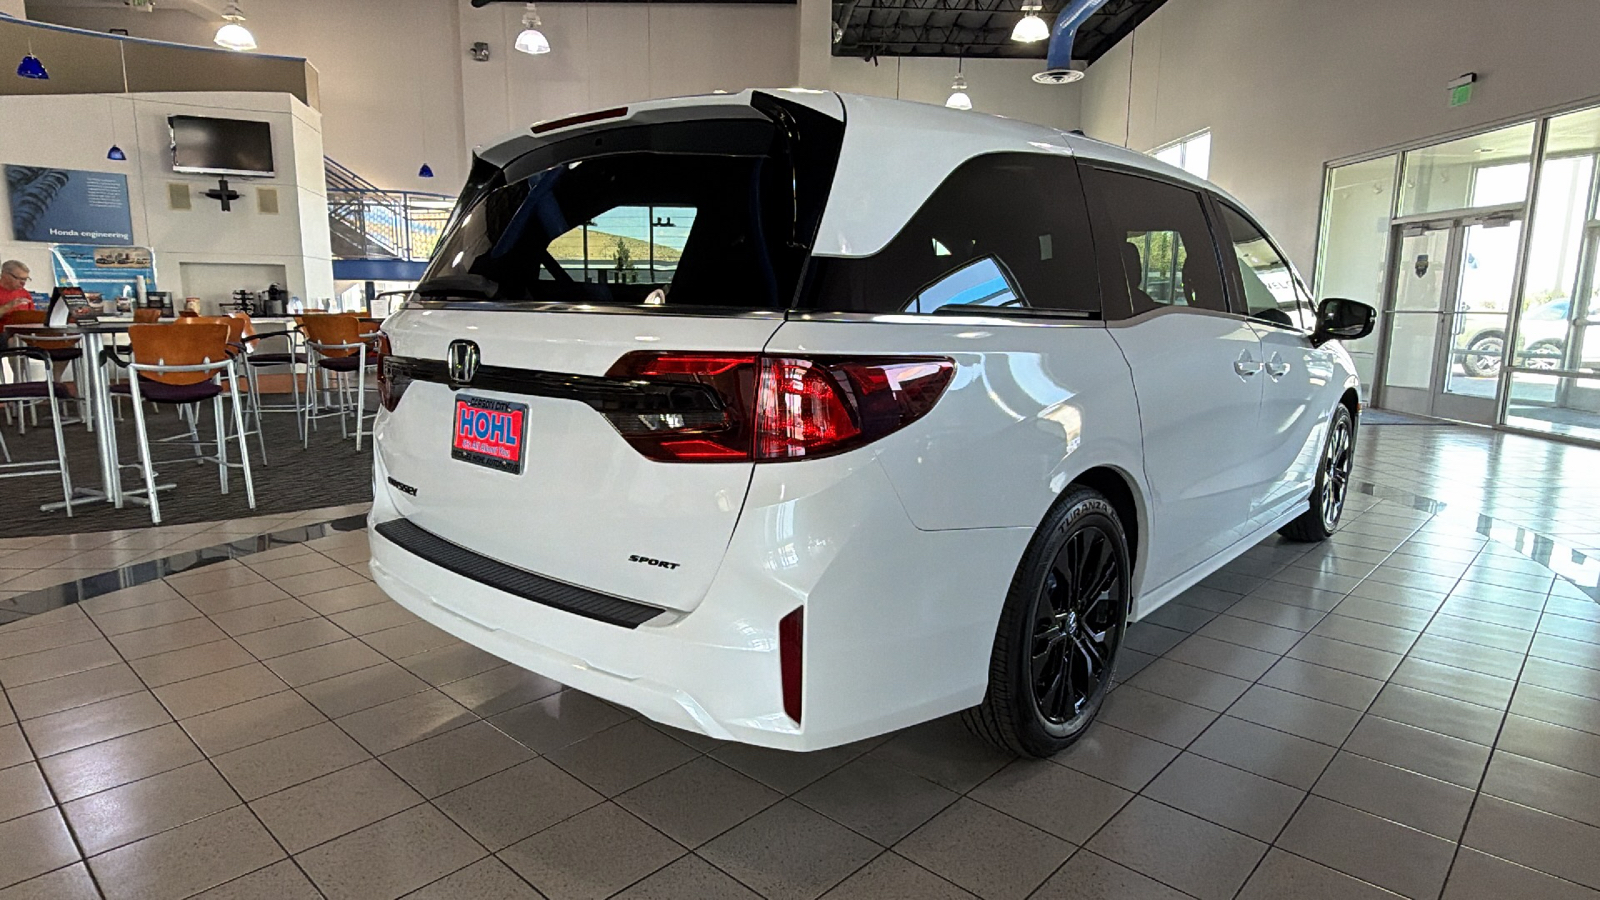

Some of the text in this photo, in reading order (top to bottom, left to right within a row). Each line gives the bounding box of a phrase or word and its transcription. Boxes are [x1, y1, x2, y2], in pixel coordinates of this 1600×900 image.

[49, 228, 129, 240] Honda engineering
[496, 401, 510, 411] CITY
[460, 408, 517, 446] HOHL
[1058, 501, 1108, 533] TURANZA
[628, 554, 681, 570] SPORT
